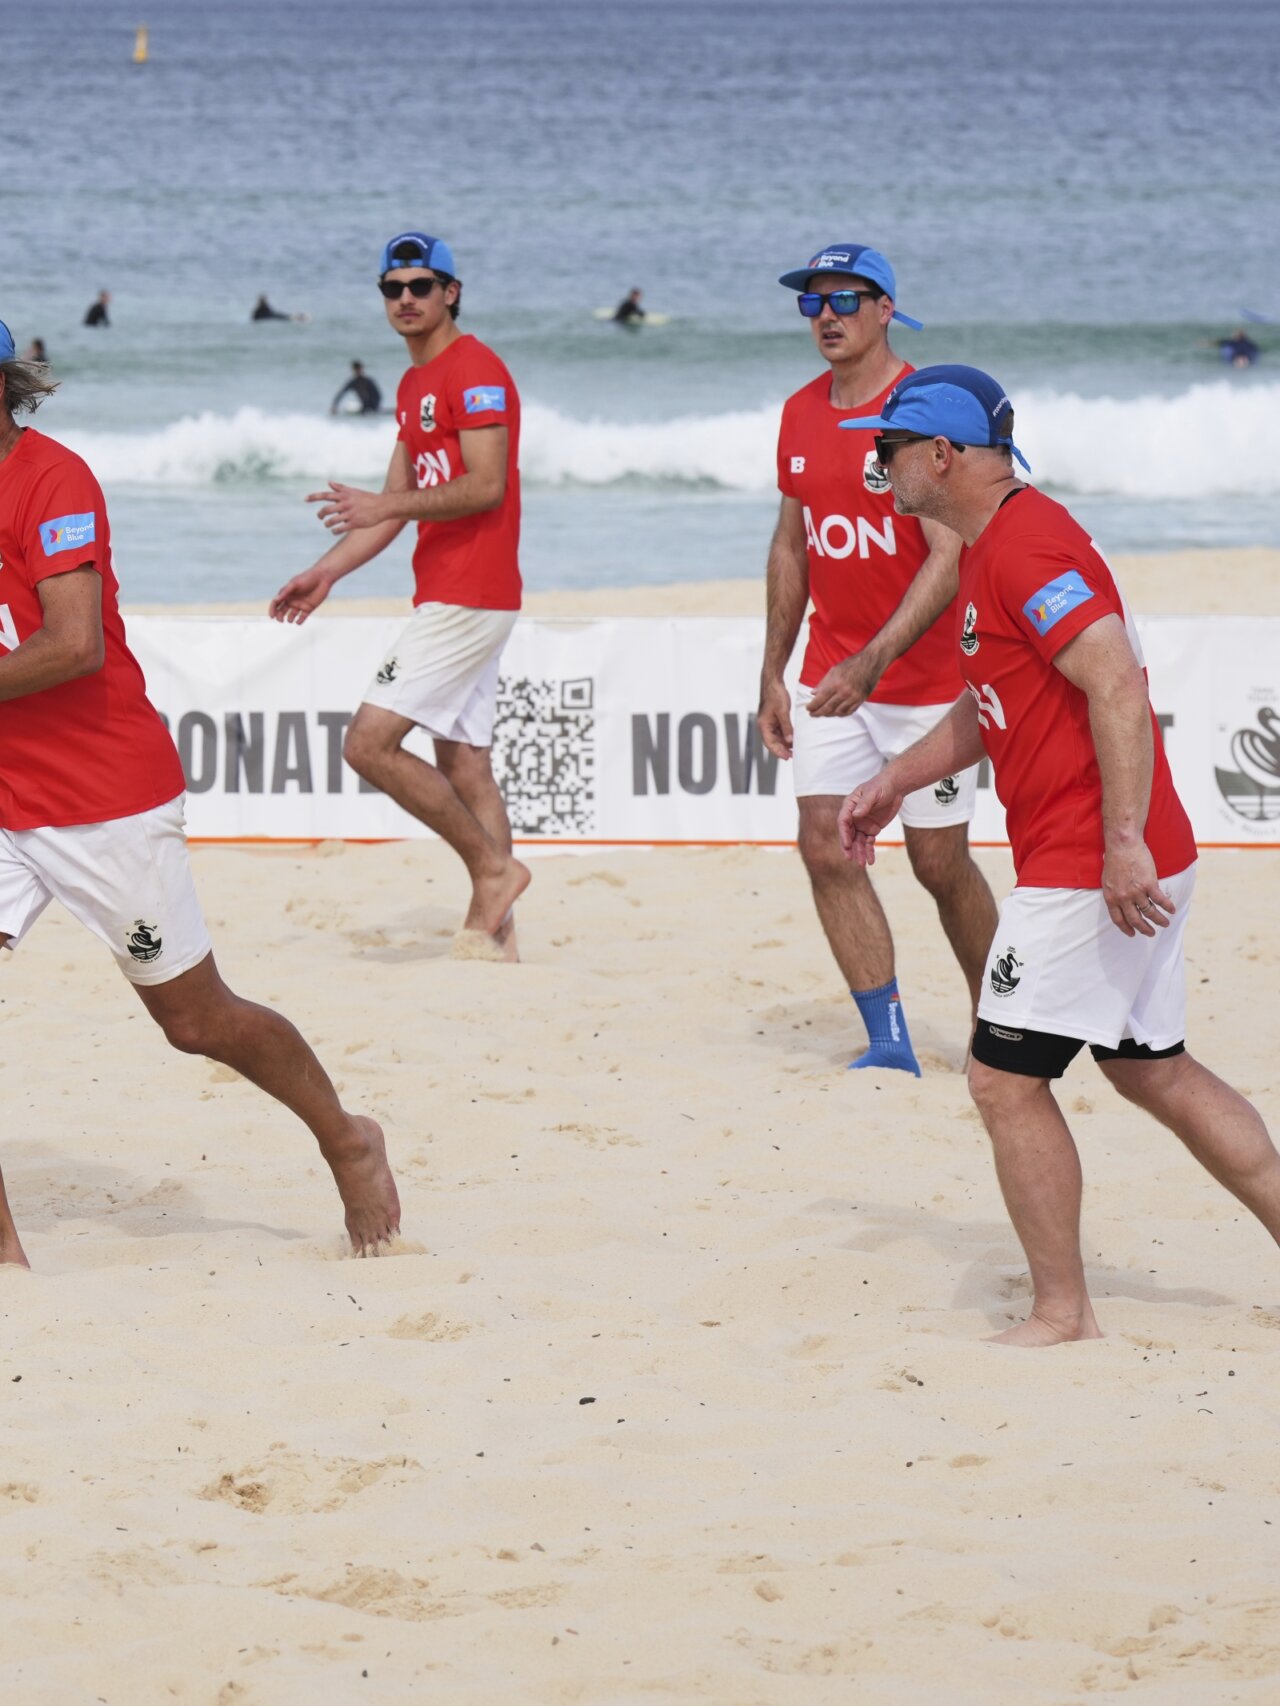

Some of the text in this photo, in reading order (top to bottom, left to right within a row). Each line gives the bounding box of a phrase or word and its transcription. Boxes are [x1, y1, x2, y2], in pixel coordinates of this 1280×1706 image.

[413, 449, 451, 488] ON
[791, 456, 805, 473] B
[65, 521, 94, 534] Beyond
[67, 533, 84, 542] Blue
[803, 506, 897, 560] AON
[1045, 584, 1074, 607] Beyond
[1050, 599, 1067, 614] Blue
[158, 710, 388, 794] ONAT
[631, 712, 779, 796] NOW
